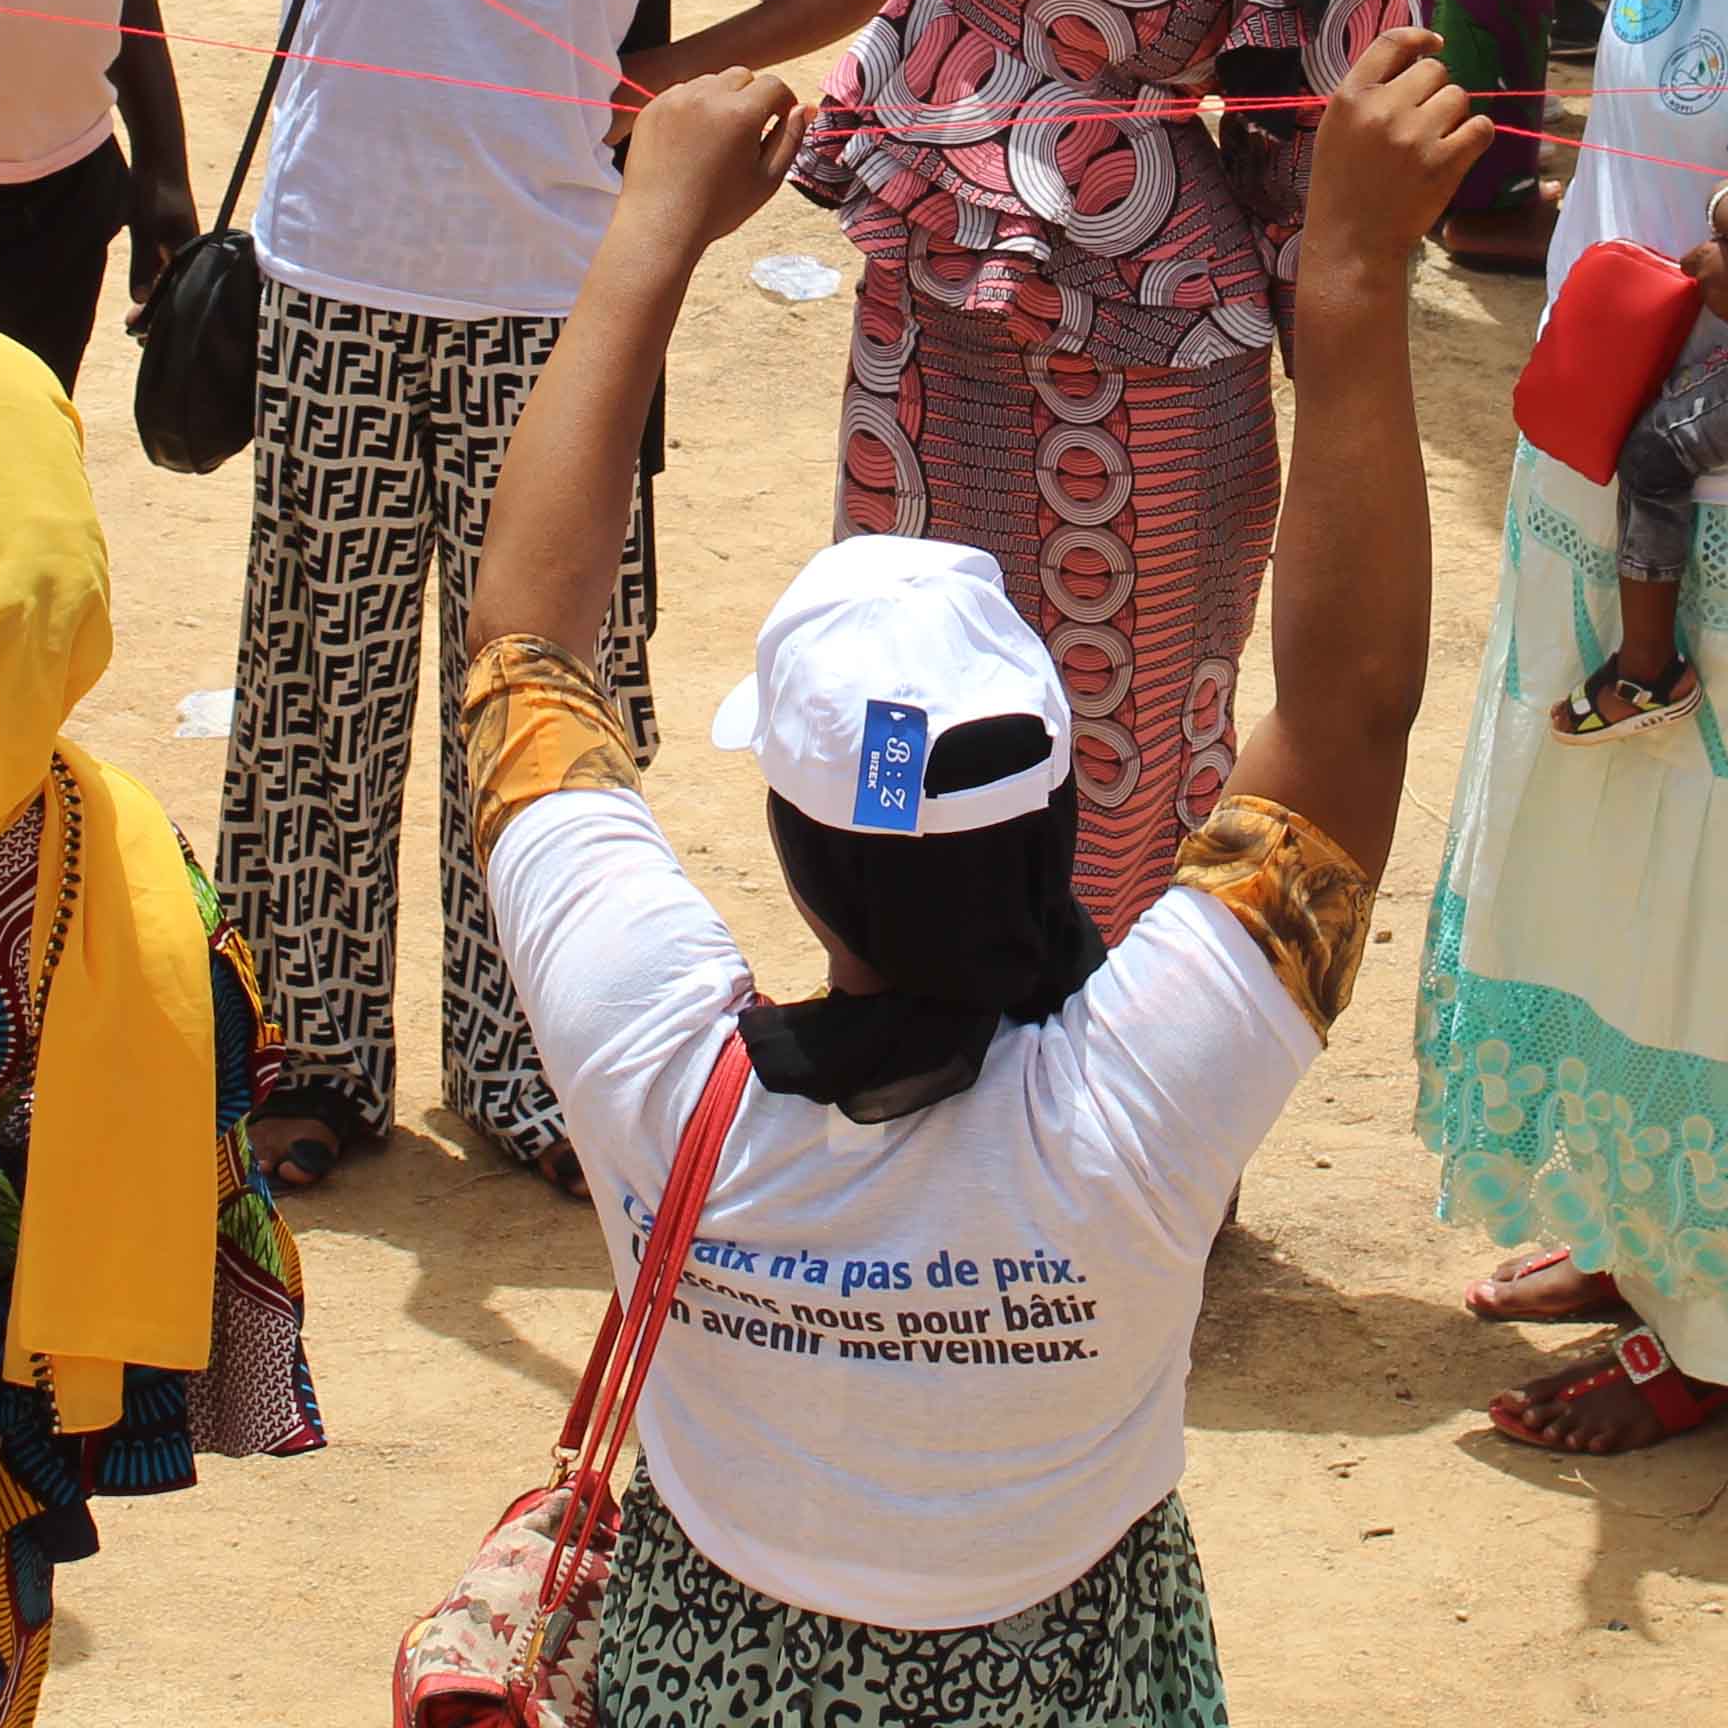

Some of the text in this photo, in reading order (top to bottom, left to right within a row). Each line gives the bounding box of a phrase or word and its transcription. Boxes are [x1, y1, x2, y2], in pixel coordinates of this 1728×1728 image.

[866, 750, 881, 790] BIZEK
[691, 1237, 761, 1273] aix
[769, 1248, 829, 1285] n'a
[841, 1257, 913, 1297] pas
[926, 1250, 979, 1289] de
[992, 1249, 1087, 1292] prix.
[701, 1306, 824, 1357] avenir
[839, 1336, 1099, 1365] merveilleux.
[790, 1302, 886, 1334] nous
[897, 1305, 990, 1338] pour
[1001, 1293, 1098, 1333] bâtir
